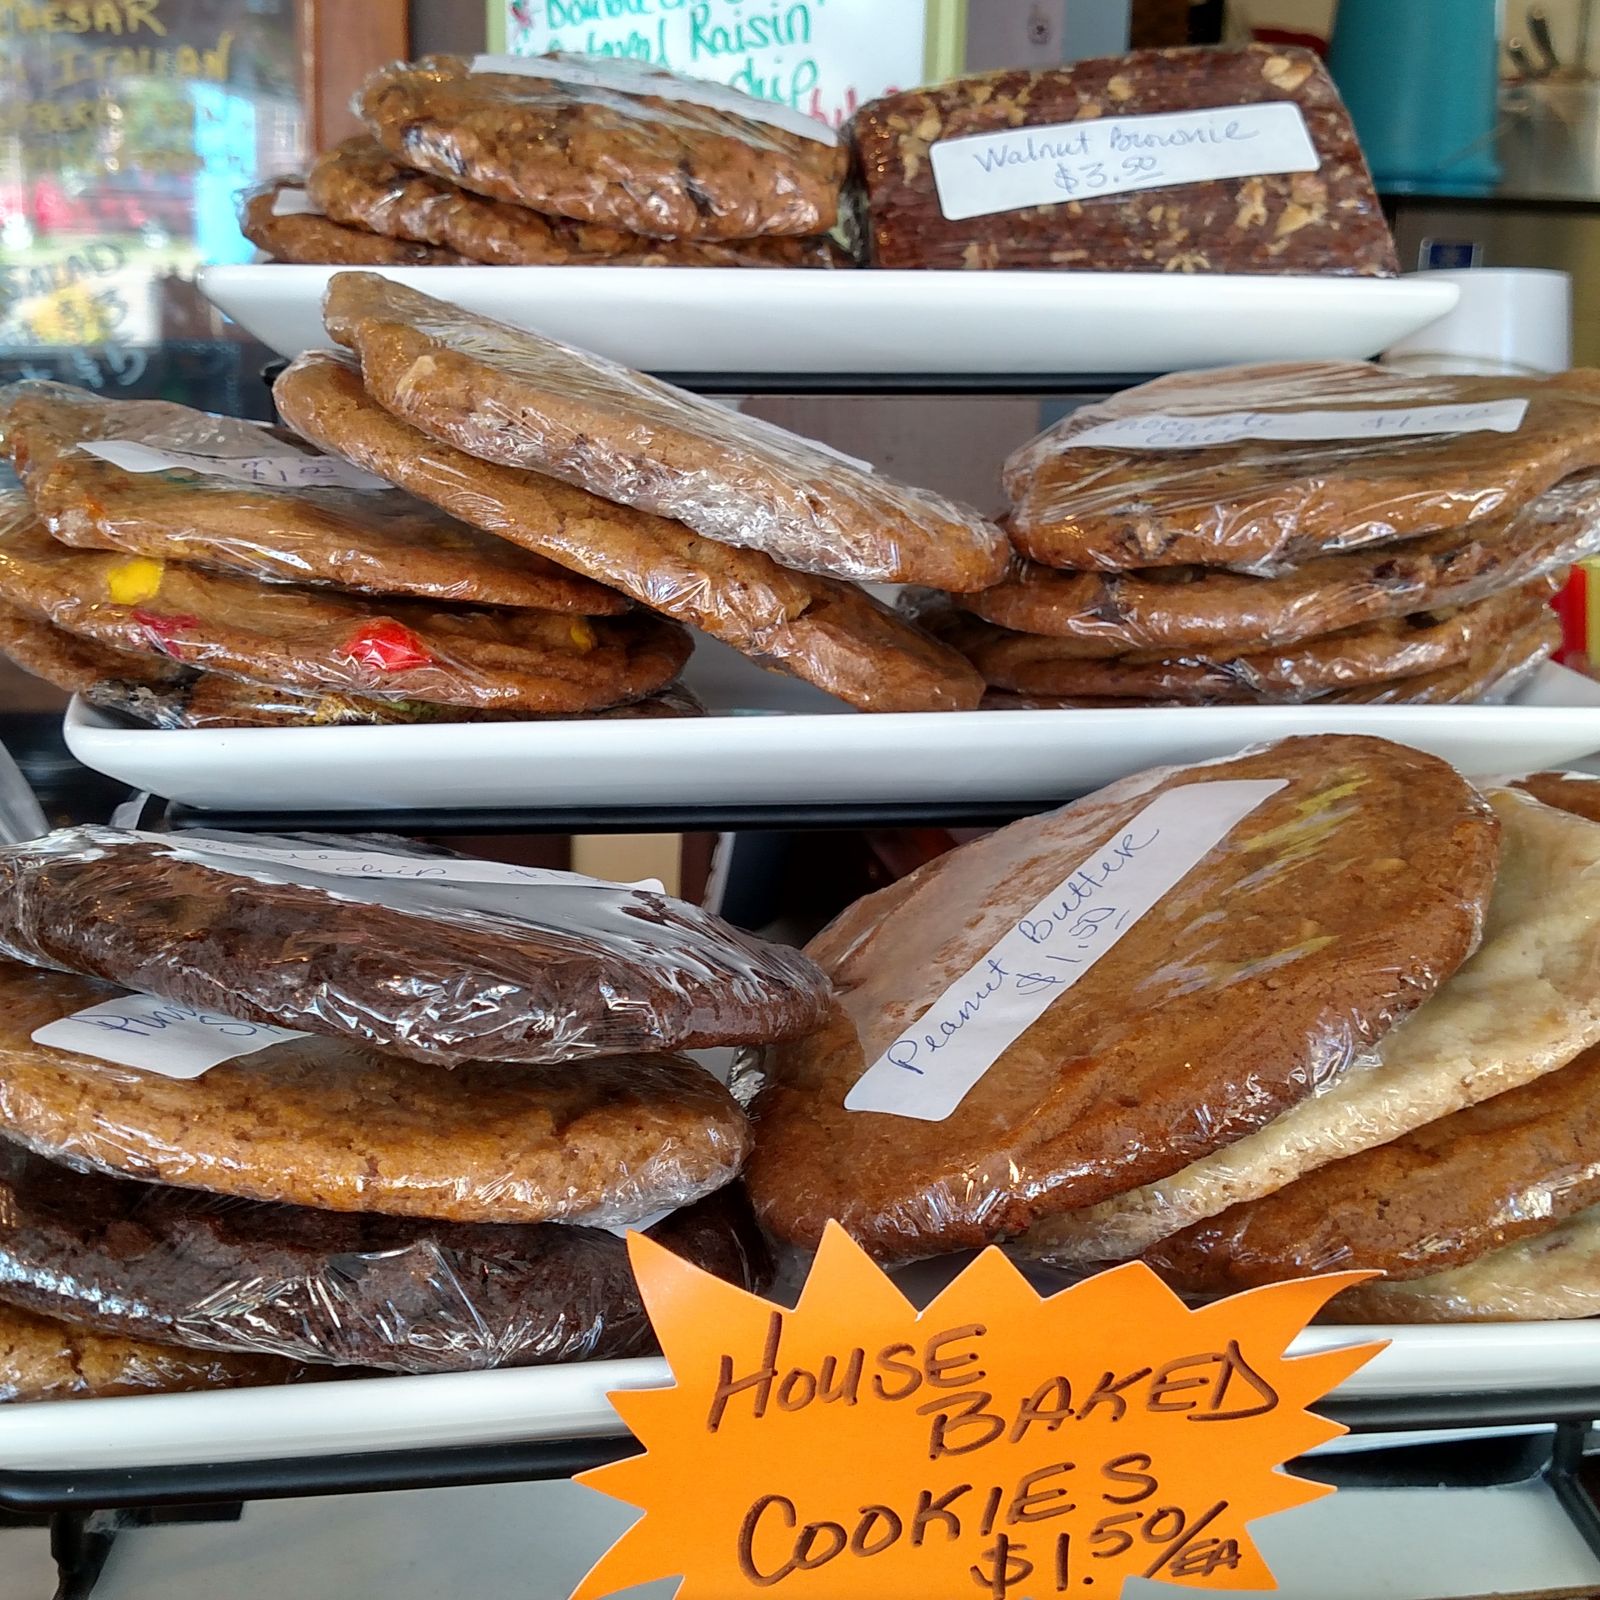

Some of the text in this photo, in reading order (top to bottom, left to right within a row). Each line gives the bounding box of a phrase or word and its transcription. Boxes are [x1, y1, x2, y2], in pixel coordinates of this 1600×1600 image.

[690, 2, 811, 60] Raisin
[973, 118, 1259, 174] Walnut Brownie
[1054, 155, 1163, 194] $3.50
[1015, 906, 1131, 996] $1.50
[887, 957, 1011, 1075] Peanut
[915, 1338, 1280, 1461] BAKED
[736, 1451, 1160, 1588] COOKIES
